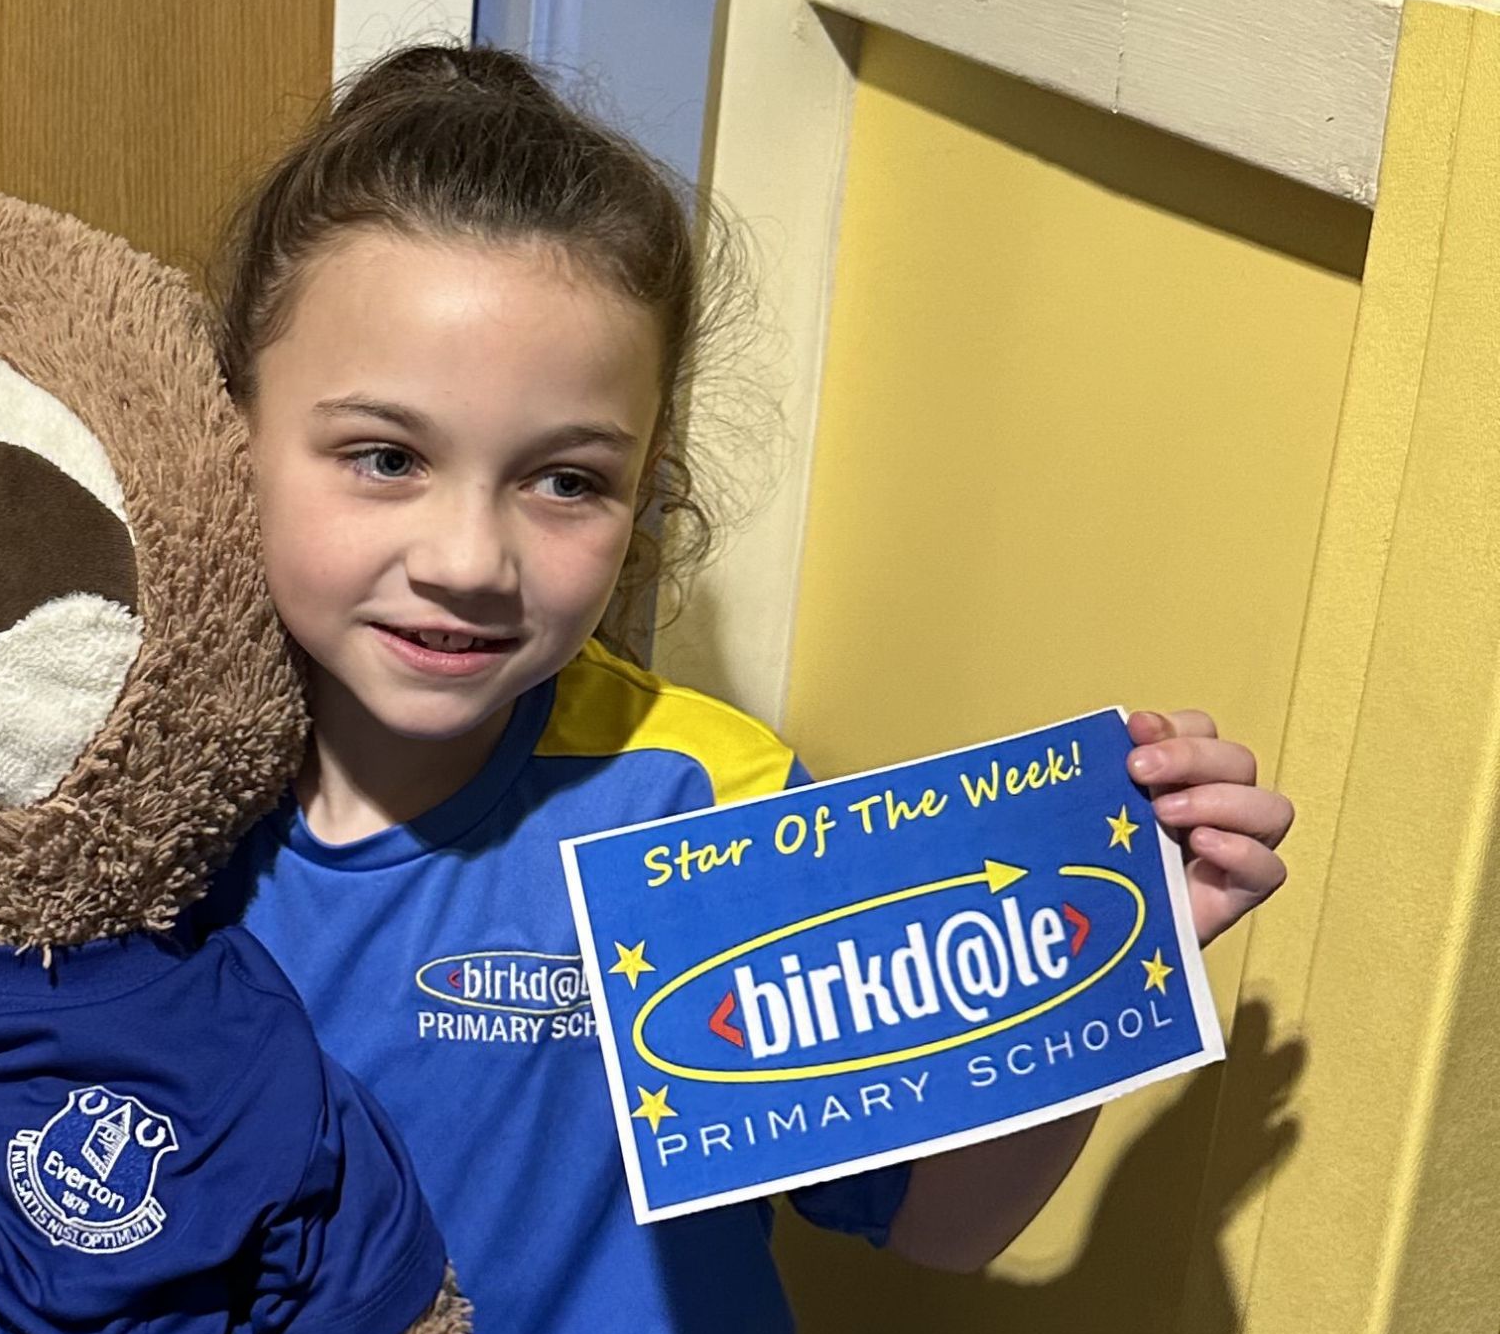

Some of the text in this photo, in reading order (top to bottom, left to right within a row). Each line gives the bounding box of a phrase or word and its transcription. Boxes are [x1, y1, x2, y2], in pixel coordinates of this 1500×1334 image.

[643, 740, 1084, 887] Star Of The Week!
[418, 1012, 598, 1043] PRIMARY SCH
[656, 999, 1173, 1167] PRIMARY SCHOOL
[11, 1150, 152, 1247] NIL SATIS NISI OPTIMUM
[43, 1150, 126, 1213] Everton
[60, 1191, 90, 1215] 1878
